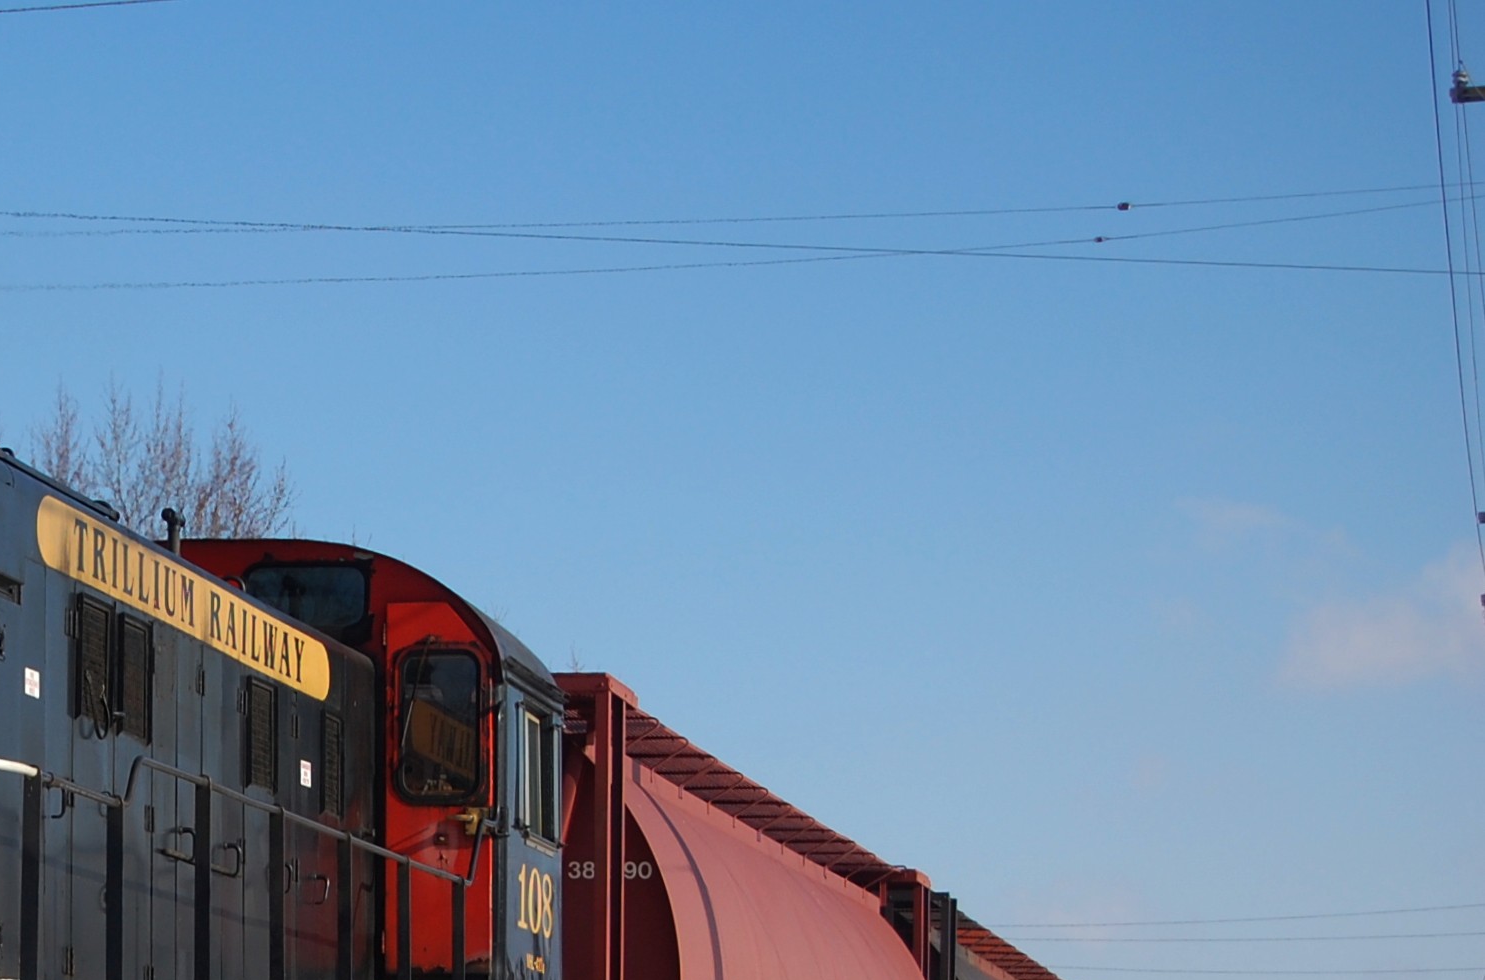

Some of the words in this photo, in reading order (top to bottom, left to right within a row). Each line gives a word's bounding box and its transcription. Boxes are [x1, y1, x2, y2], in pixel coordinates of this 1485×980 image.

[74, 518, 195, 628] TRILLIUM
[210, 590, 305, 683] RAILWAY
[517, 863, 553, 938] 108
